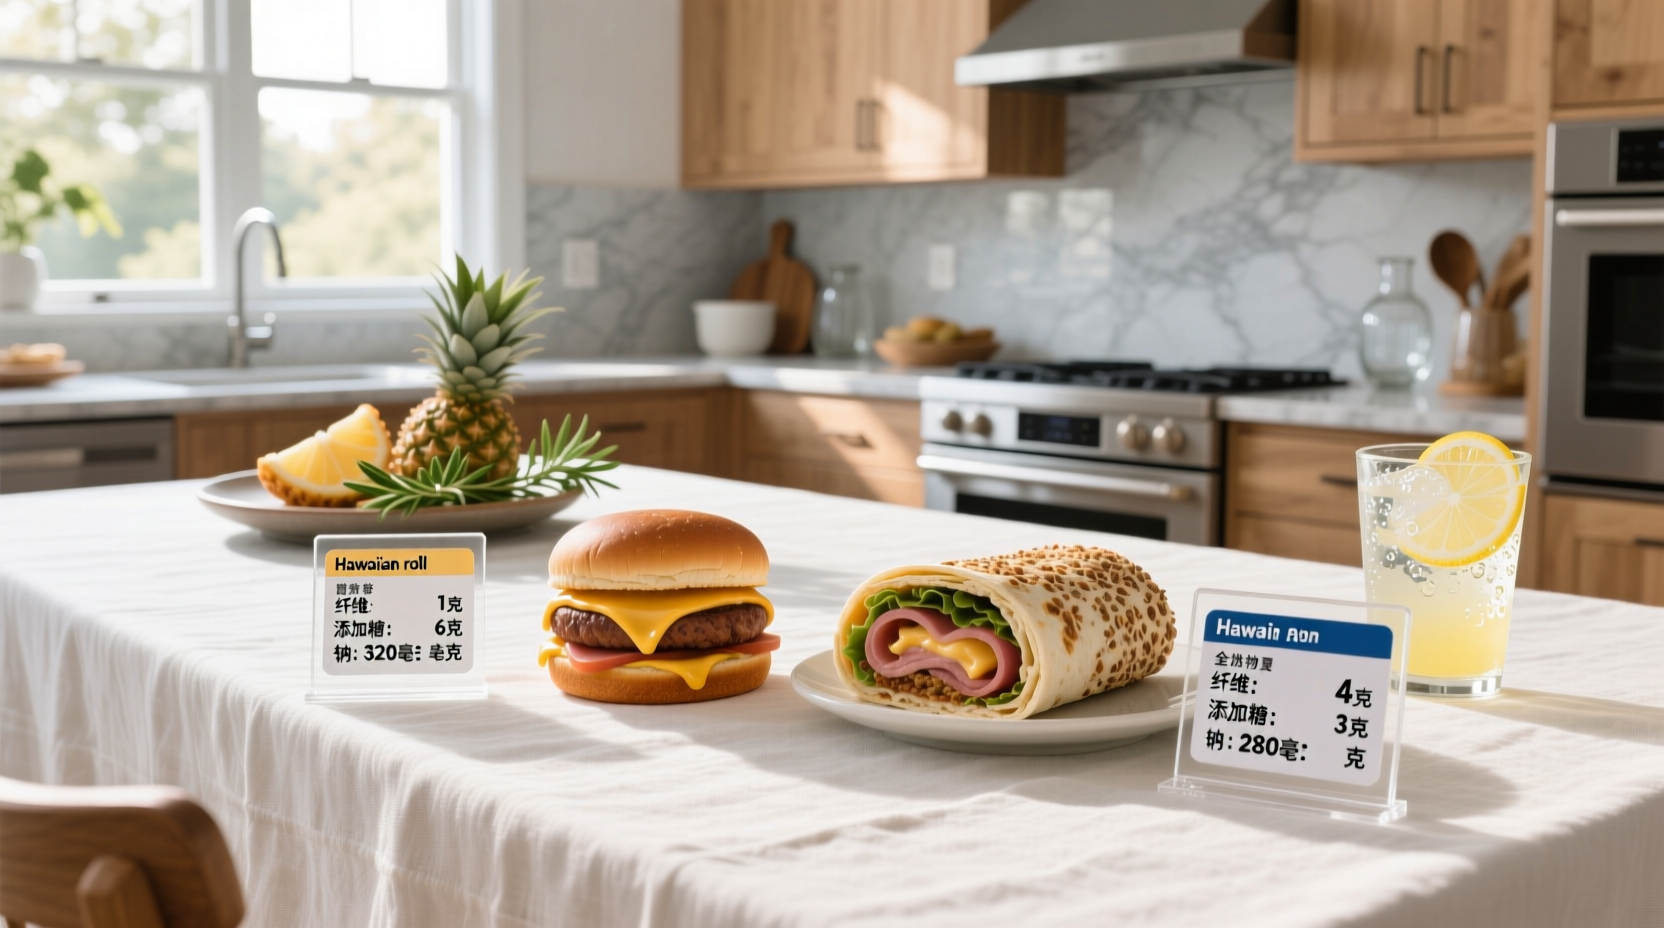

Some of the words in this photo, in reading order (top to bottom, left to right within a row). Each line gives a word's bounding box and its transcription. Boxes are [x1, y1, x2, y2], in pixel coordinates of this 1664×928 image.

[404, 555, 428, 571] roll
[437, 594, 463, 613] 1克
[434, 618, 463, 637] 6克
[1335, 678, 1373, 708] 4克
[1334, 713, 1369, 739] 3克
[1343, 746, 1367, 770] 克
